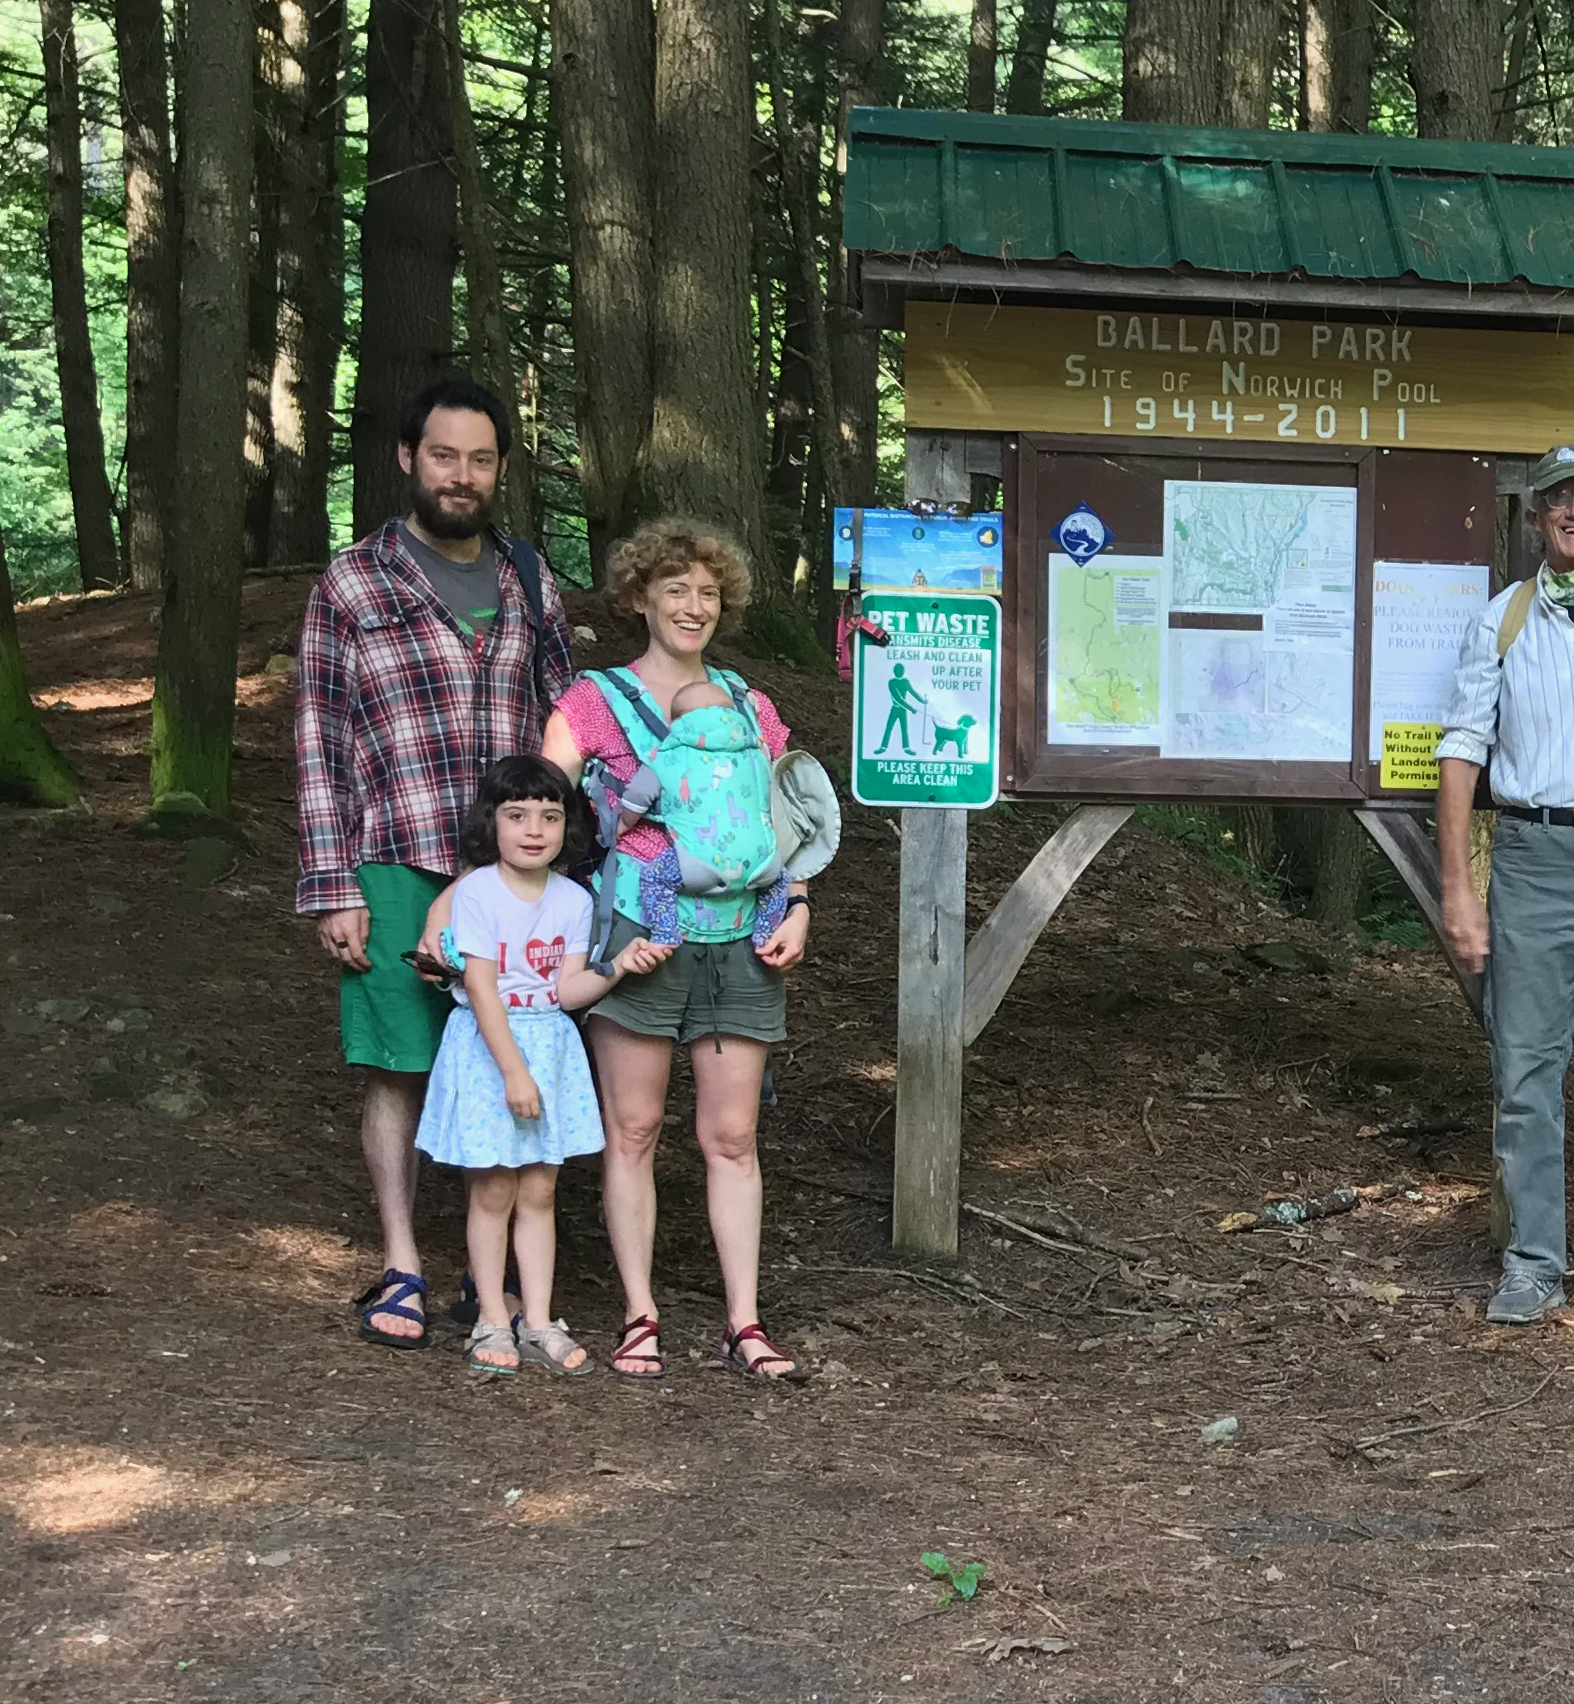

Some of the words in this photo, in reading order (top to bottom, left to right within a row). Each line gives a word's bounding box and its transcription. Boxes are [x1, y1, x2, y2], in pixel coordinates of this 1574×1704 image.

[1097, 314, 1280, 358] BALLARD
[1312, 325, 1413, 362] PARK
[1103, 395, 1408, 441] 1944-2011
[868, 610, 909, 632] PET
[916, 612, 990, 635] WASTE
[1390, 621, 1419, 633] DOG
[889, 635, 936, 648] ANSMITS
[938, 636, 982, 649] DISEASE
[1387, 637, 1425, 649] FROM
[886, 648, 920, 661] LEASH
[923, 650, 945, 662] AND
[948, 650, 983, 664] CLEAN
[931, 664, 947, 677] UP
[949, 665, 983, 678] AFTER
[931, 678, 960, 691] YOUR
[962, 680, 982, 692] PET
[1384, 730, 1401, 739] No
[1404, 731, 1432, 740] Trail
[1386, 743, 1431, 754] Without
[877, 761, 917, 775] PLEASE
[919, 762, 947, 775] KEEP
[948, 763, 974, 776] THIS
[1391, 770, 1438, 781] Permiss
[892, 773, 921, 786] AREA
[923, 774, 958, 787] CLEAN
